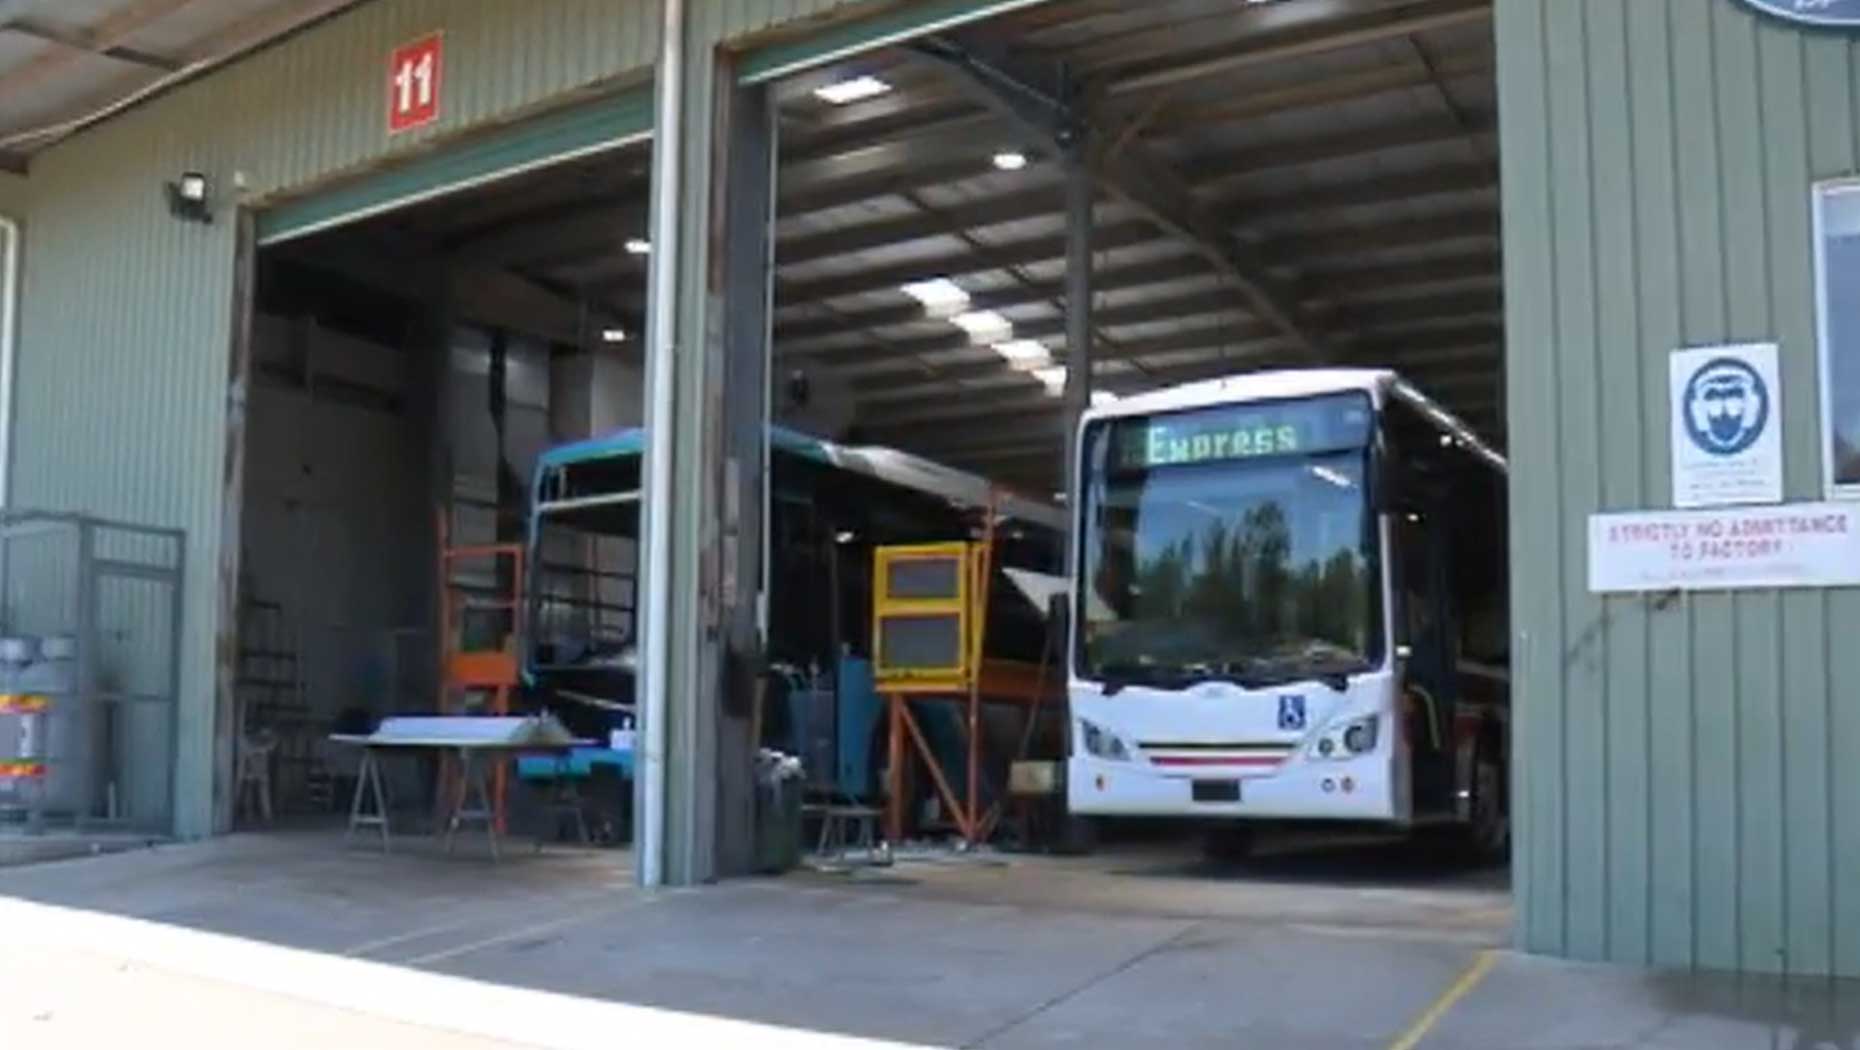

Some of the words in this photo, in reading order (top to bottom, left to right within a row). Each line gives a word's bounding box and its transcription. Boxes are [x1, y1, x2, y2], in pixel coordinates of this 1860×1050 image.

[393, 53, 432, 112] 11
[1147, 425, 1298, 464] Express
[1608, 522, 1690, 543] STRICTLY
[1697, 519, 1723, 538] NO
[1731, 514, 1848, 538] ADMITTANCE
[1669, 544, 1693, 560] TO
[1700, 540, 1782, 561] FACTORY
